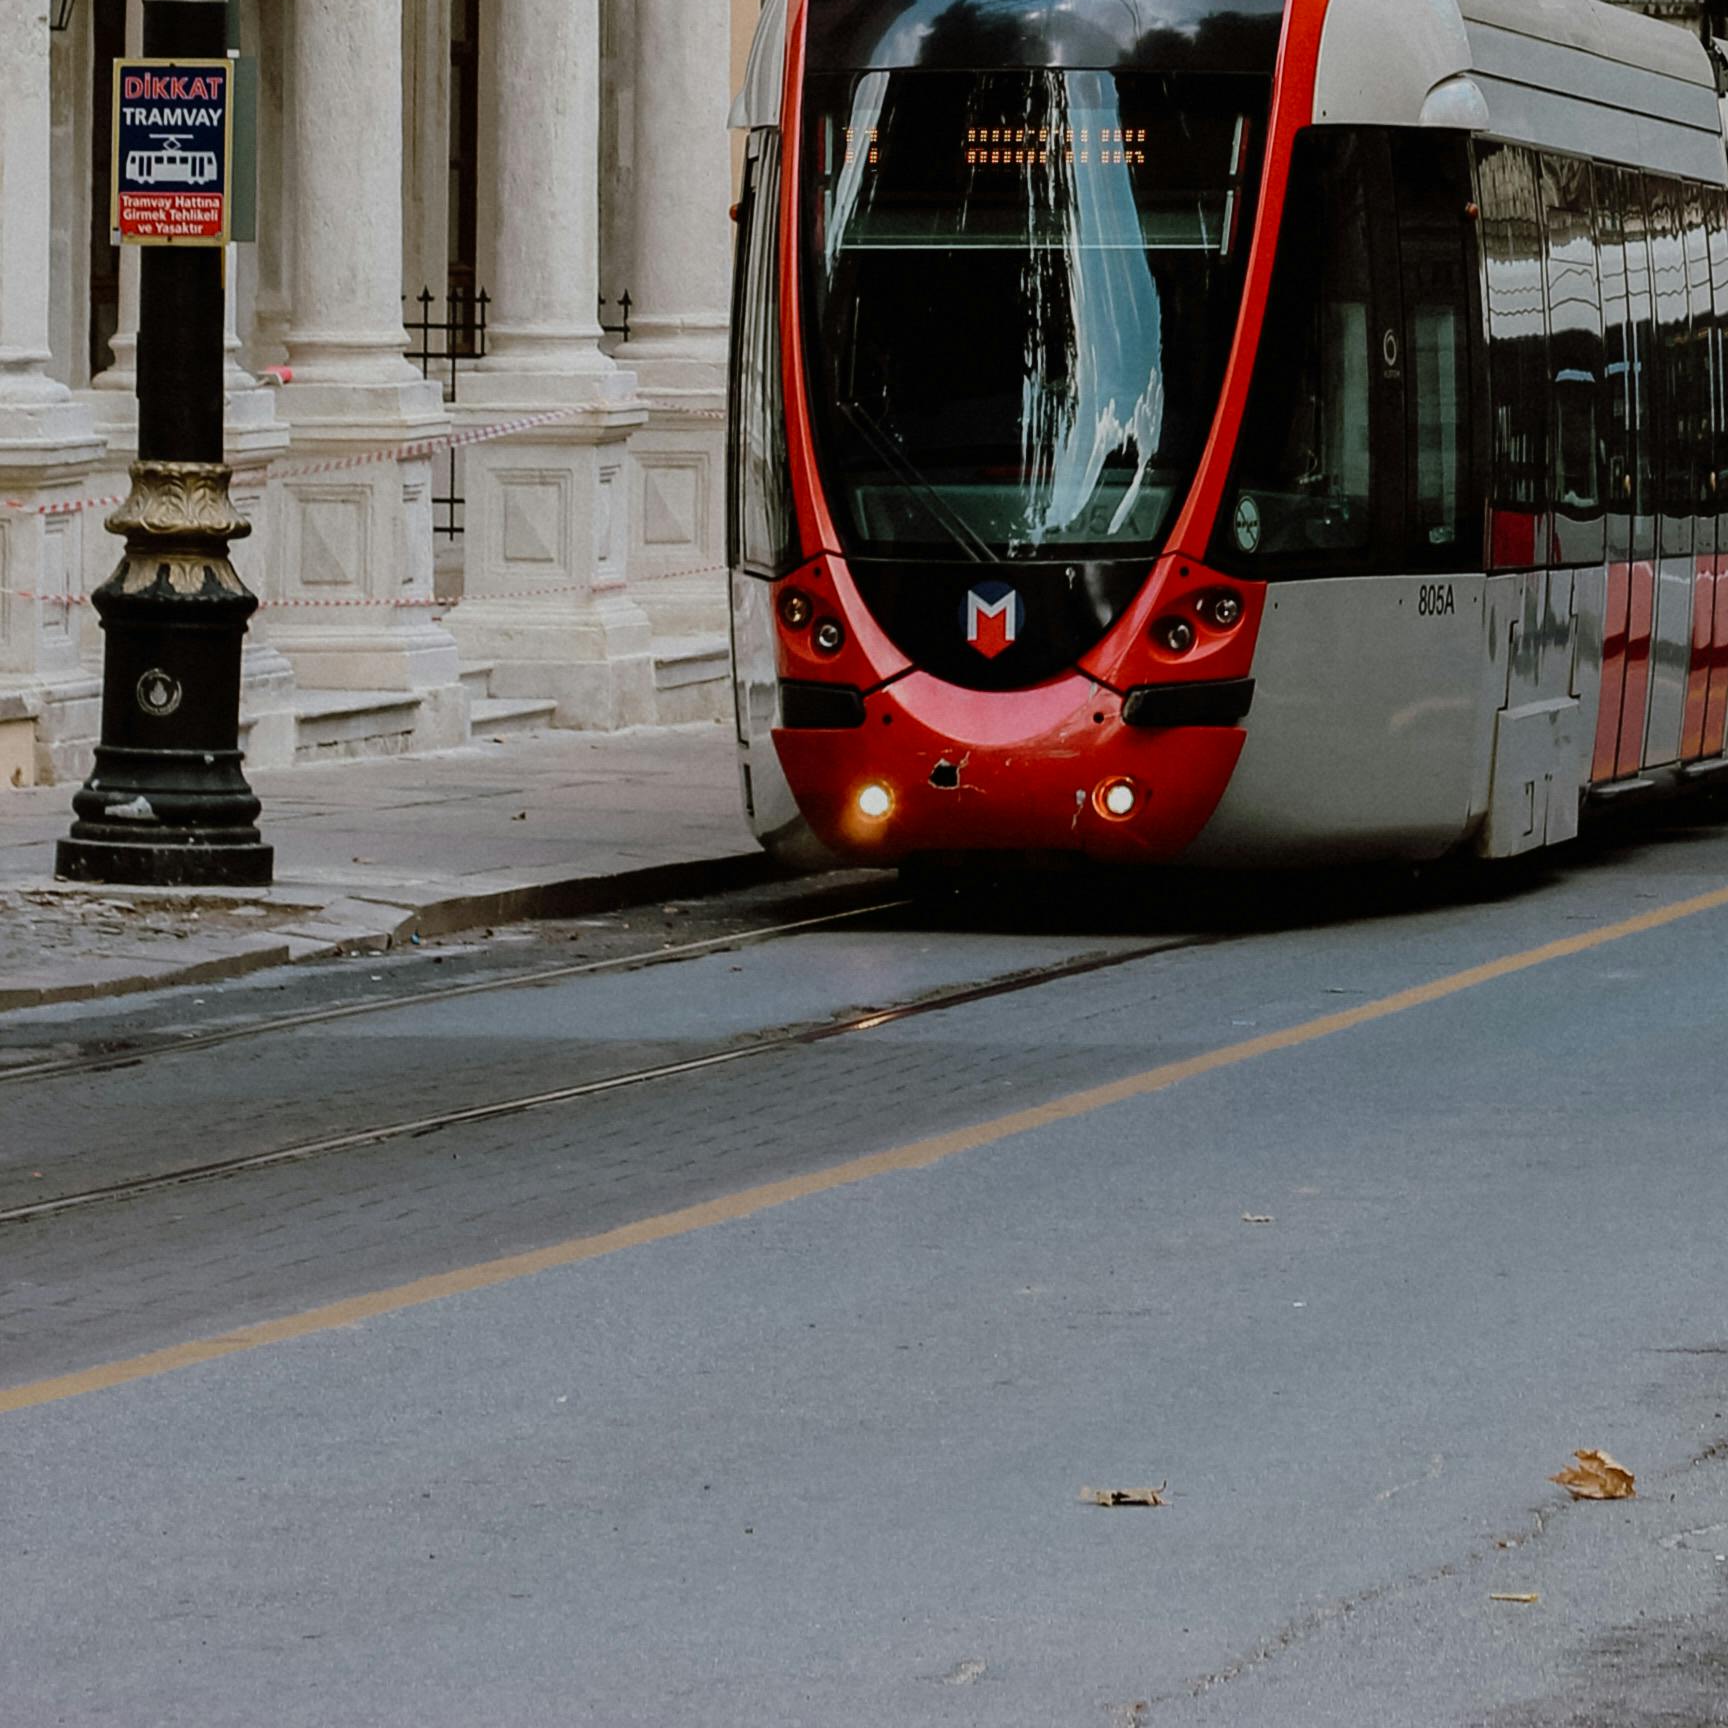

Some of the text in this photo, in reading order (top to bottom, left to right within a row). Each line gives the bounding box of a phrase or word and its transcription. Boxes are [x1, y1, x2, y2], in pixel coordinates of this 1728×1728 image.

[125, 73, 223, 100] DİKKAT
[123, 108, 222, 126] TRAMVAY
[122, 196, 219, 209] Tramvay Hattına
[123, 209, 218, 220] Girmek Tehlikeli
[138, 222, 203, 234] ve Yasaktır
[1418, 584, 1455, 616] 805A
